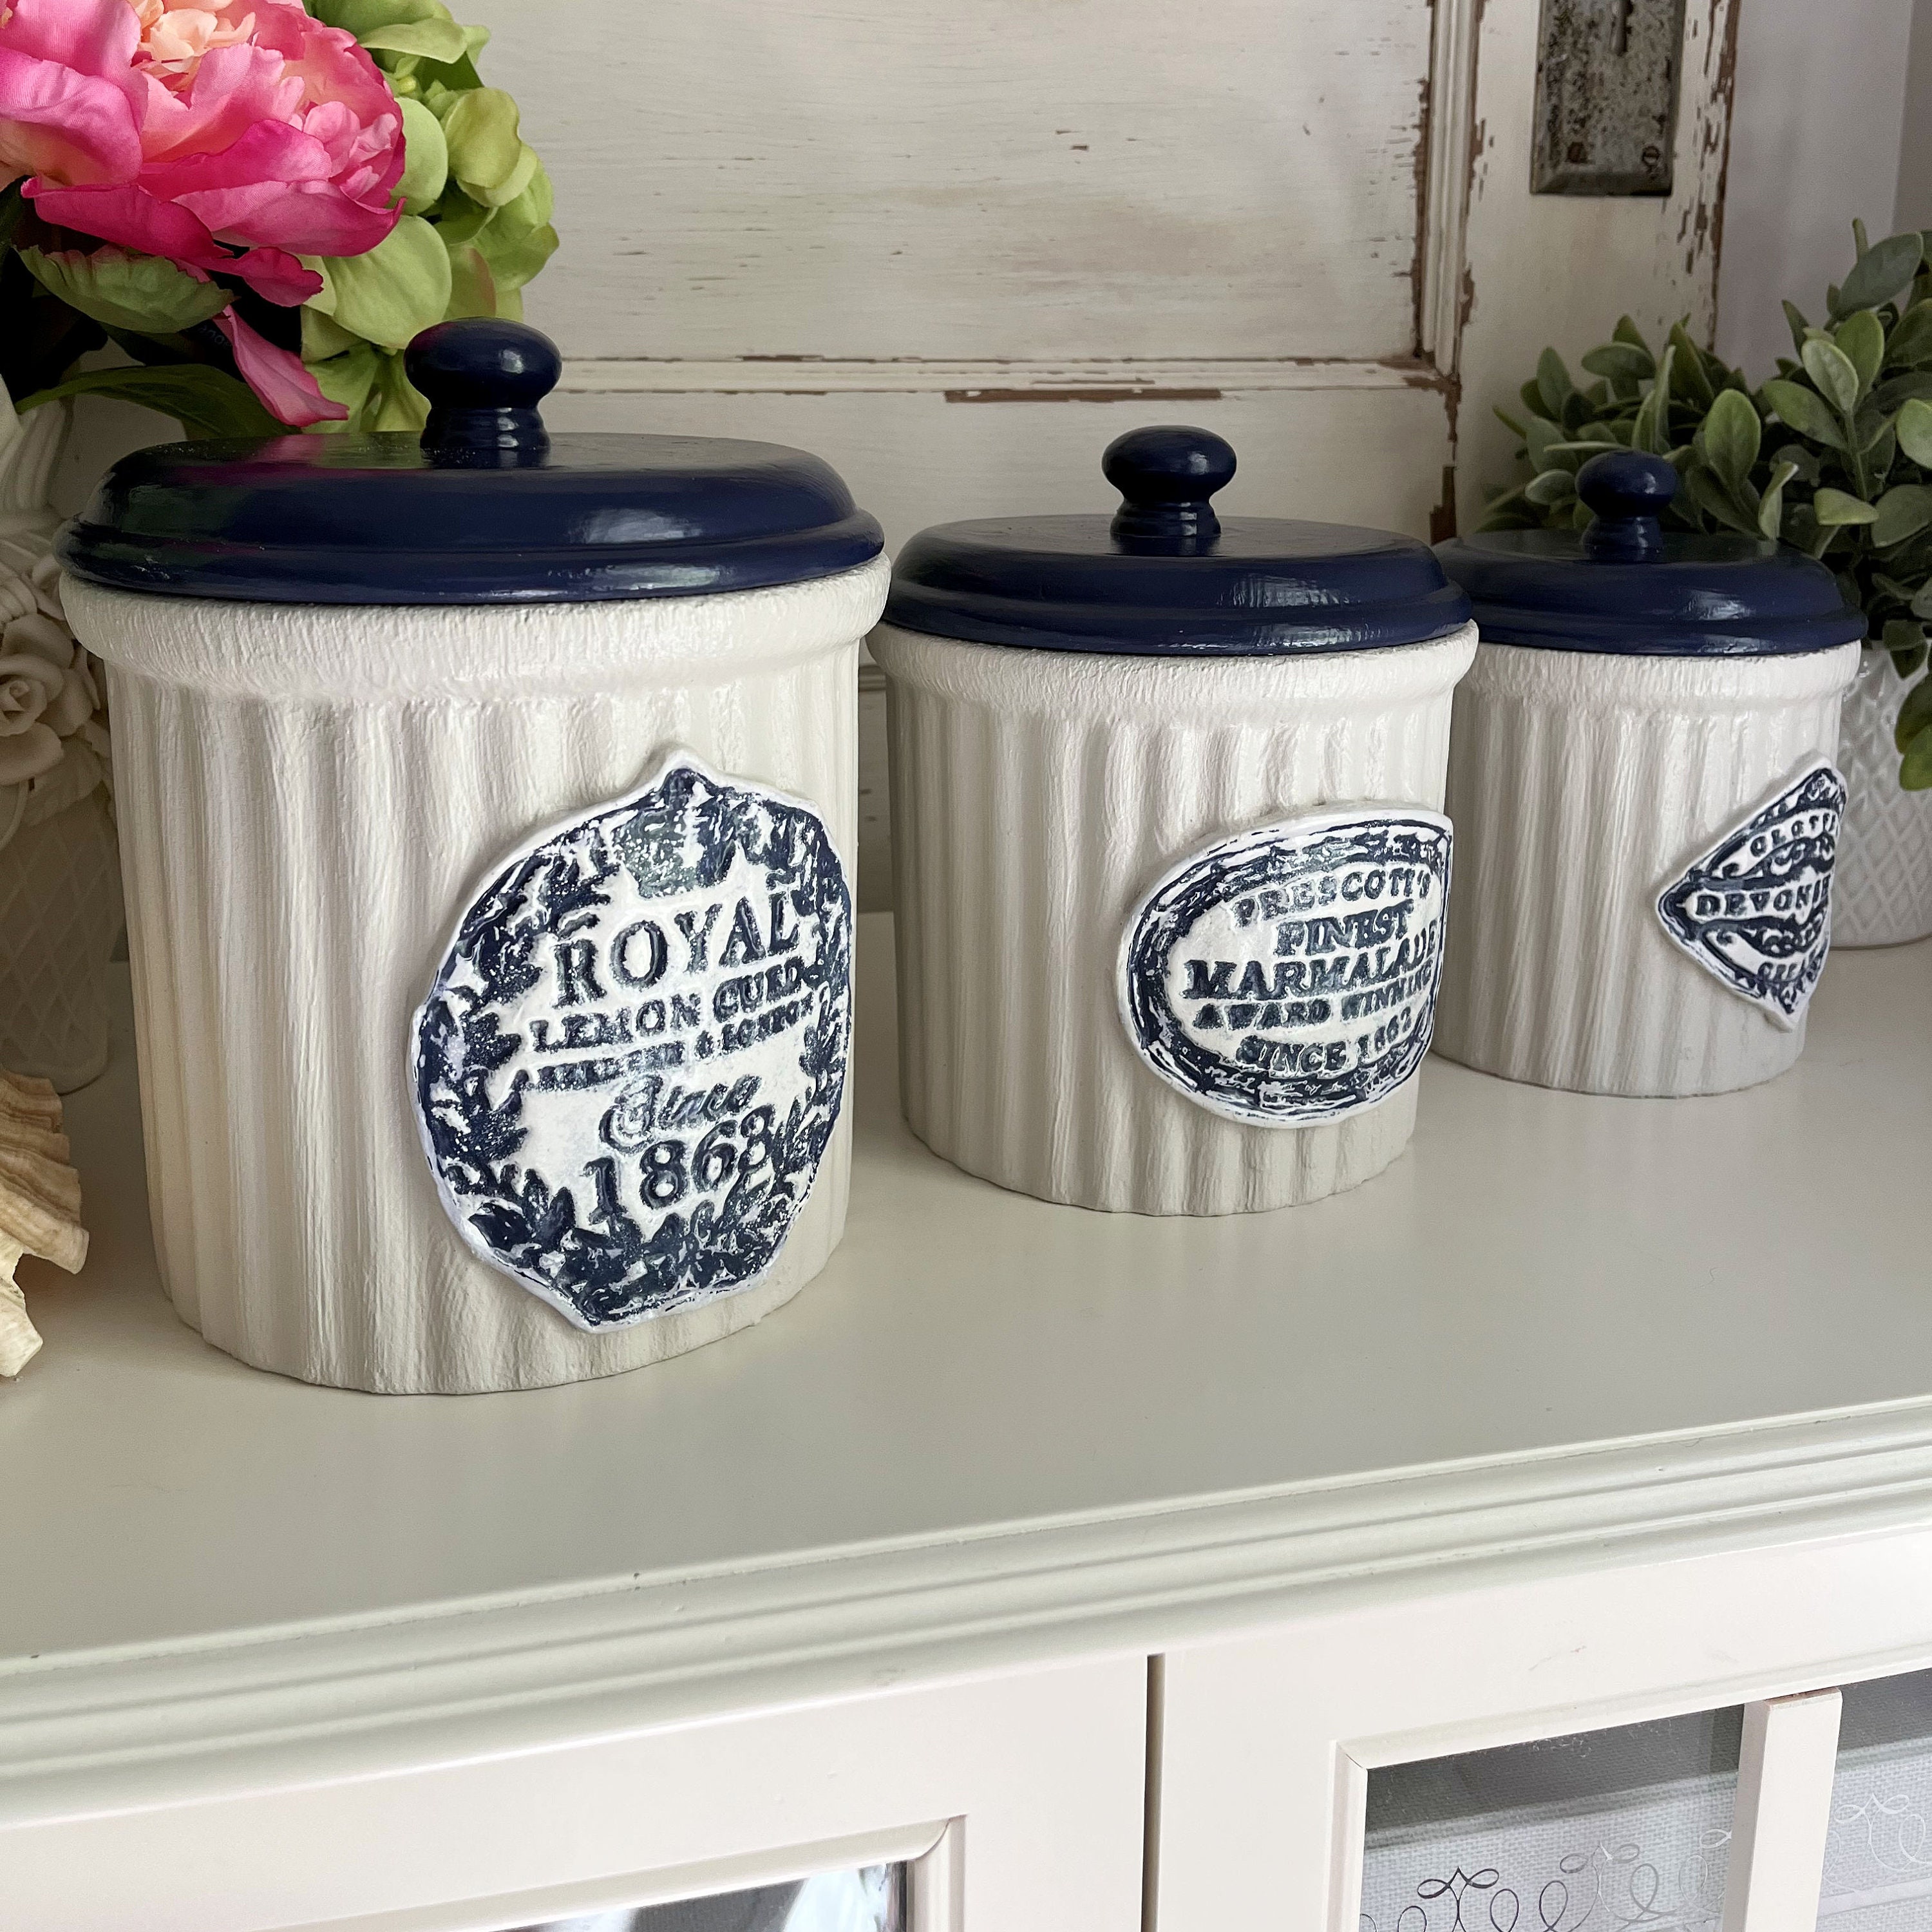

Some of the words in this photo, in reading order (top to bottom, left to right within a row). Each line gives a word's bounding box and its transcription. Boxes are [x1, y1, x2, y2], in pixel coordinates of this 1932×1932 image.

[552, 892, 799, 1009] ROYAL
[1180, 919, 1437, 1001] MARMALADE
[1273, 899, 1415, 956] FINEST
[529, 992, 702, 1054] LEMON
[712, 956, 805, 1023] CURD
[1191, 998, 1332, 1031] AWARD
[1340, 959, 1434, 1021] WINNING
[1235, 1034, 1347, 1072] SINCE
[598, 1072, 762, 1155] Since
[582, 1103, 776, 1217] 1868
